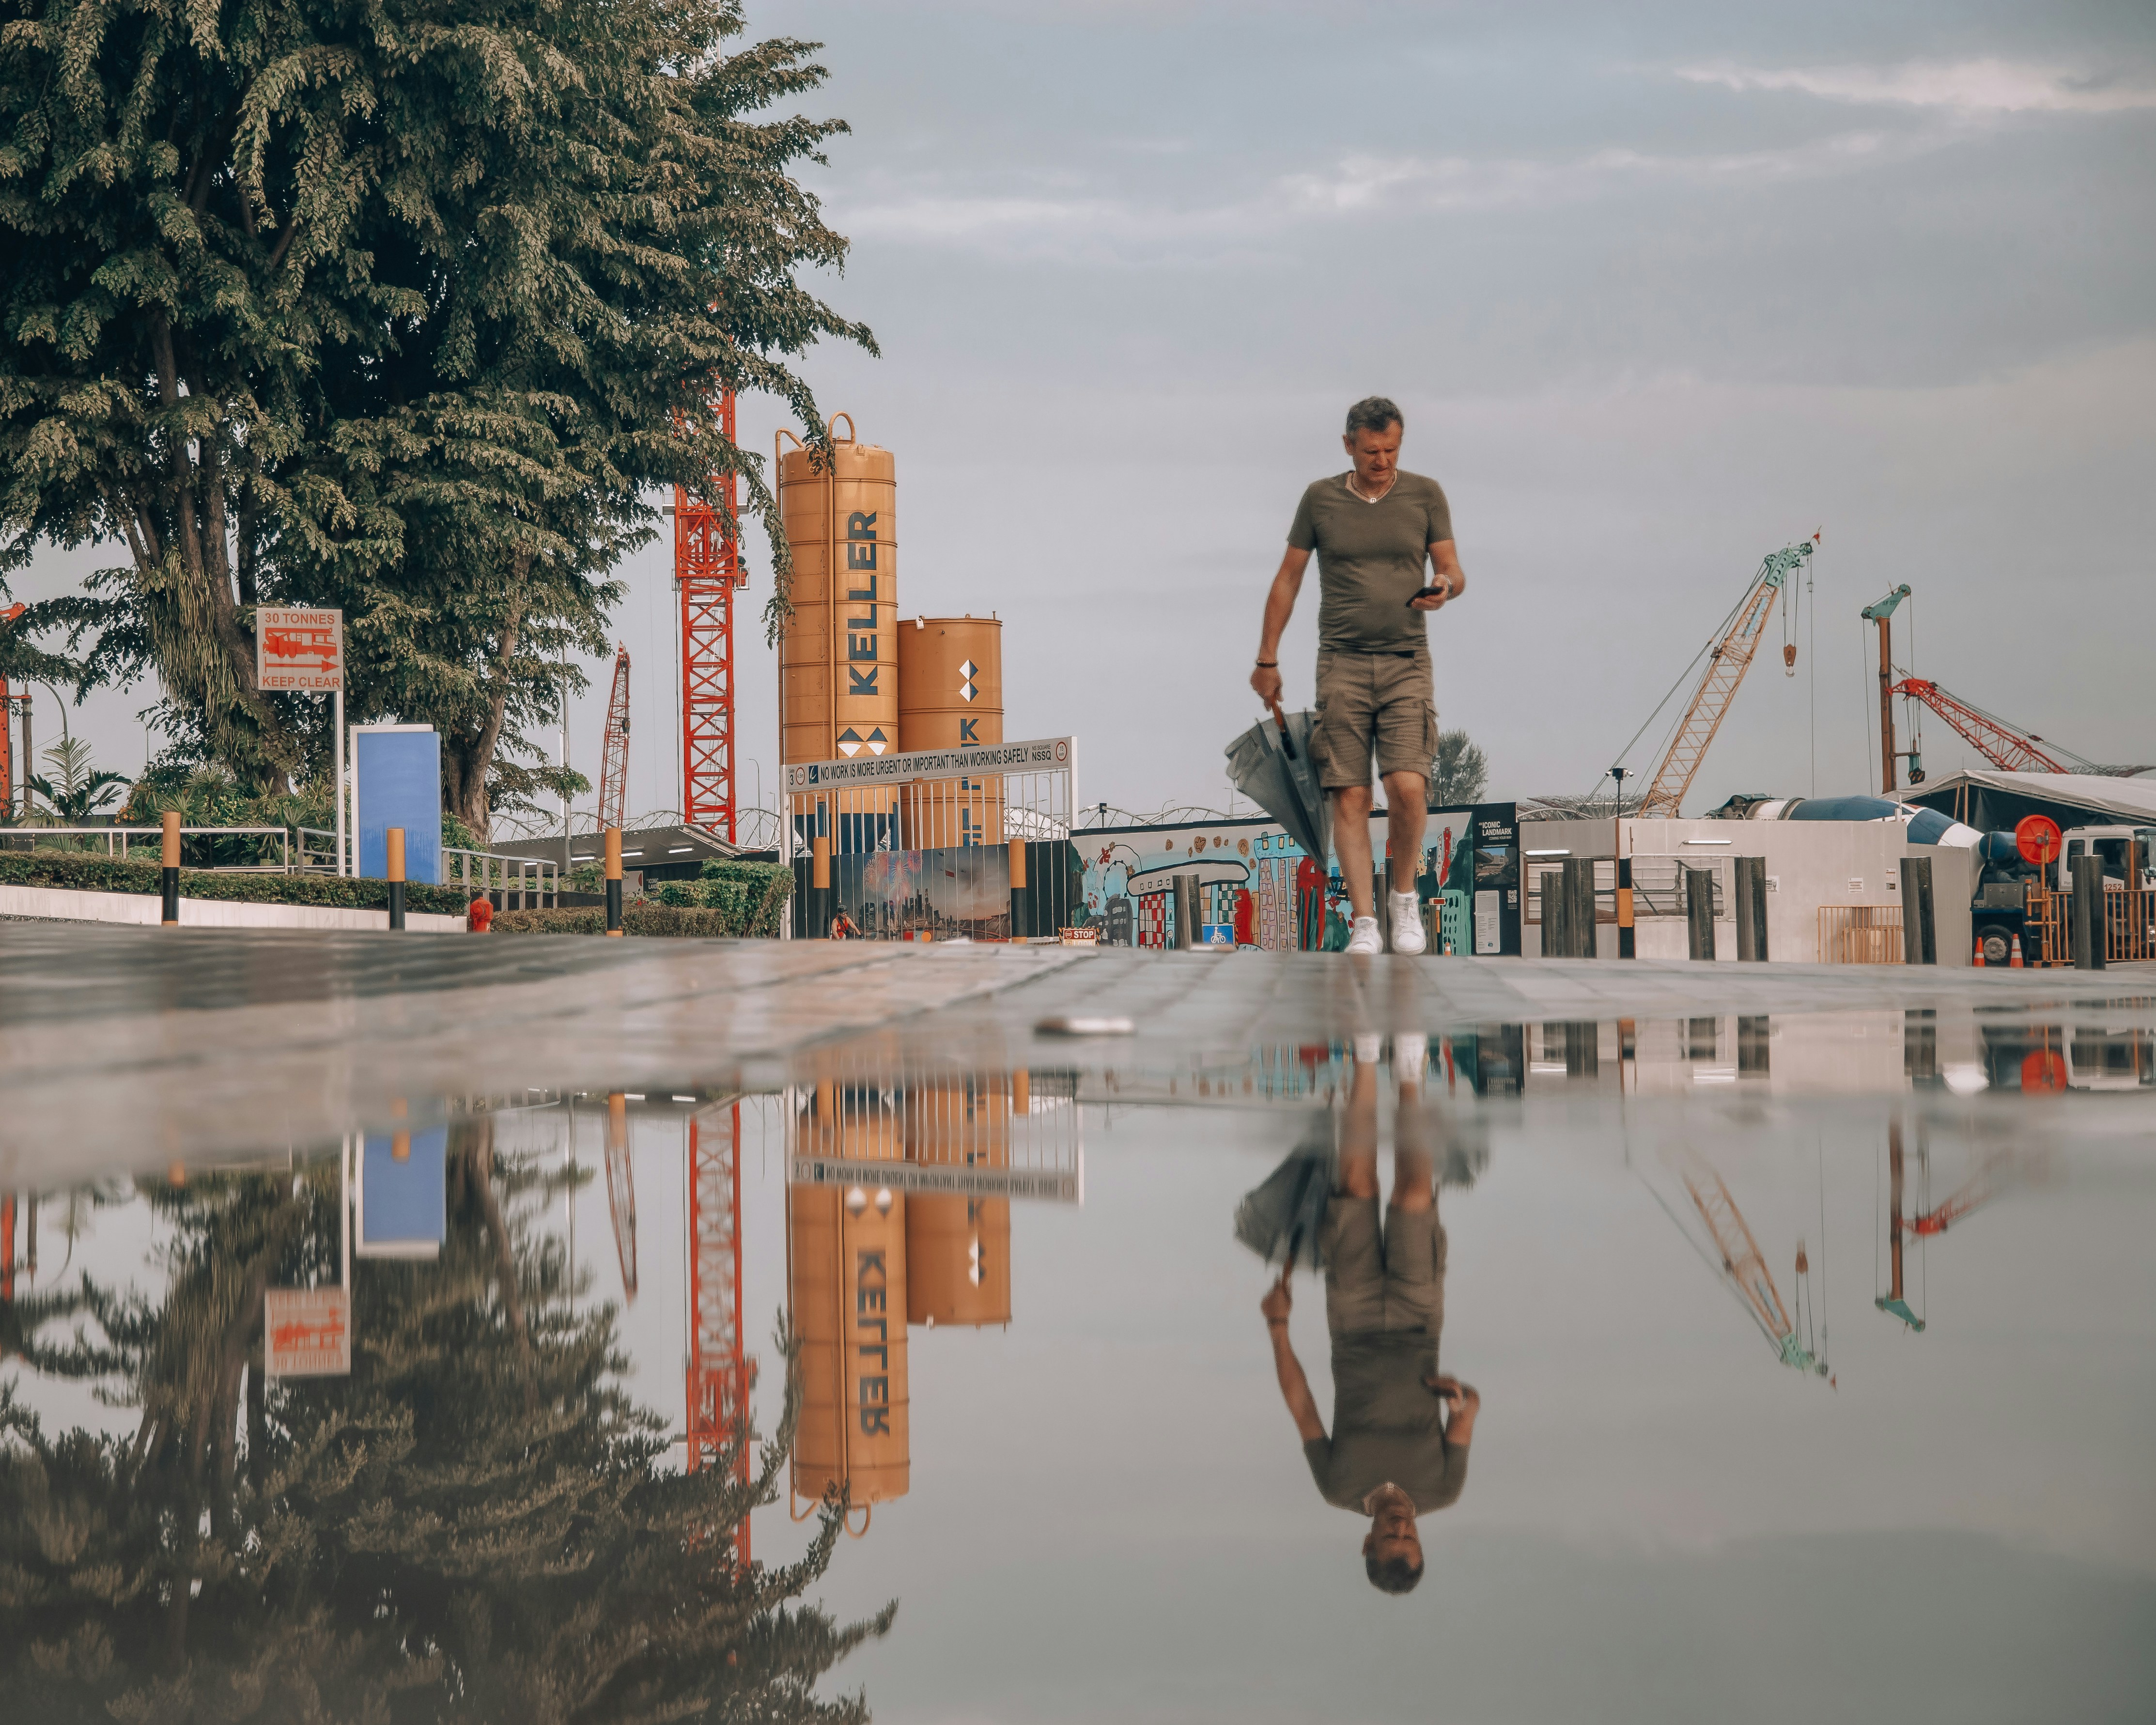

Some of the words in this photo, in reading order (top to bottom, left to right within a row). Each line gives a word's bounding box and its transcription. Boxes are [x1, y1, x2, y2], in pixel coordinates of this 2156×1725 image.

[848, 511, 878, 695] KELLER
[265, 613, 279, 623] 30
[282, 613, 335, 624] TONNES
[263, 676, 295, 686] KEEP
[298, 677, 341, 687] CLEAR
[1032, 750, 1051, 761] NSSQ
[821, 766, 829, 780] NO
[830, 764, 849, 779] WORK
[850, 763, 855, 777] IS
[857, 761, 874, 777] MORE
[876, 759, 900, 775] URGENT
[902, 758, 912, 773] OR
[913, 754, 949, 771] IMPORTANT
[951, 753, 968, 769] THAN
[970, 750, 1002, 767] WORKING
[1003, 747, 1028, 764] SAFELY
[790, 774, 794, 785] 3
